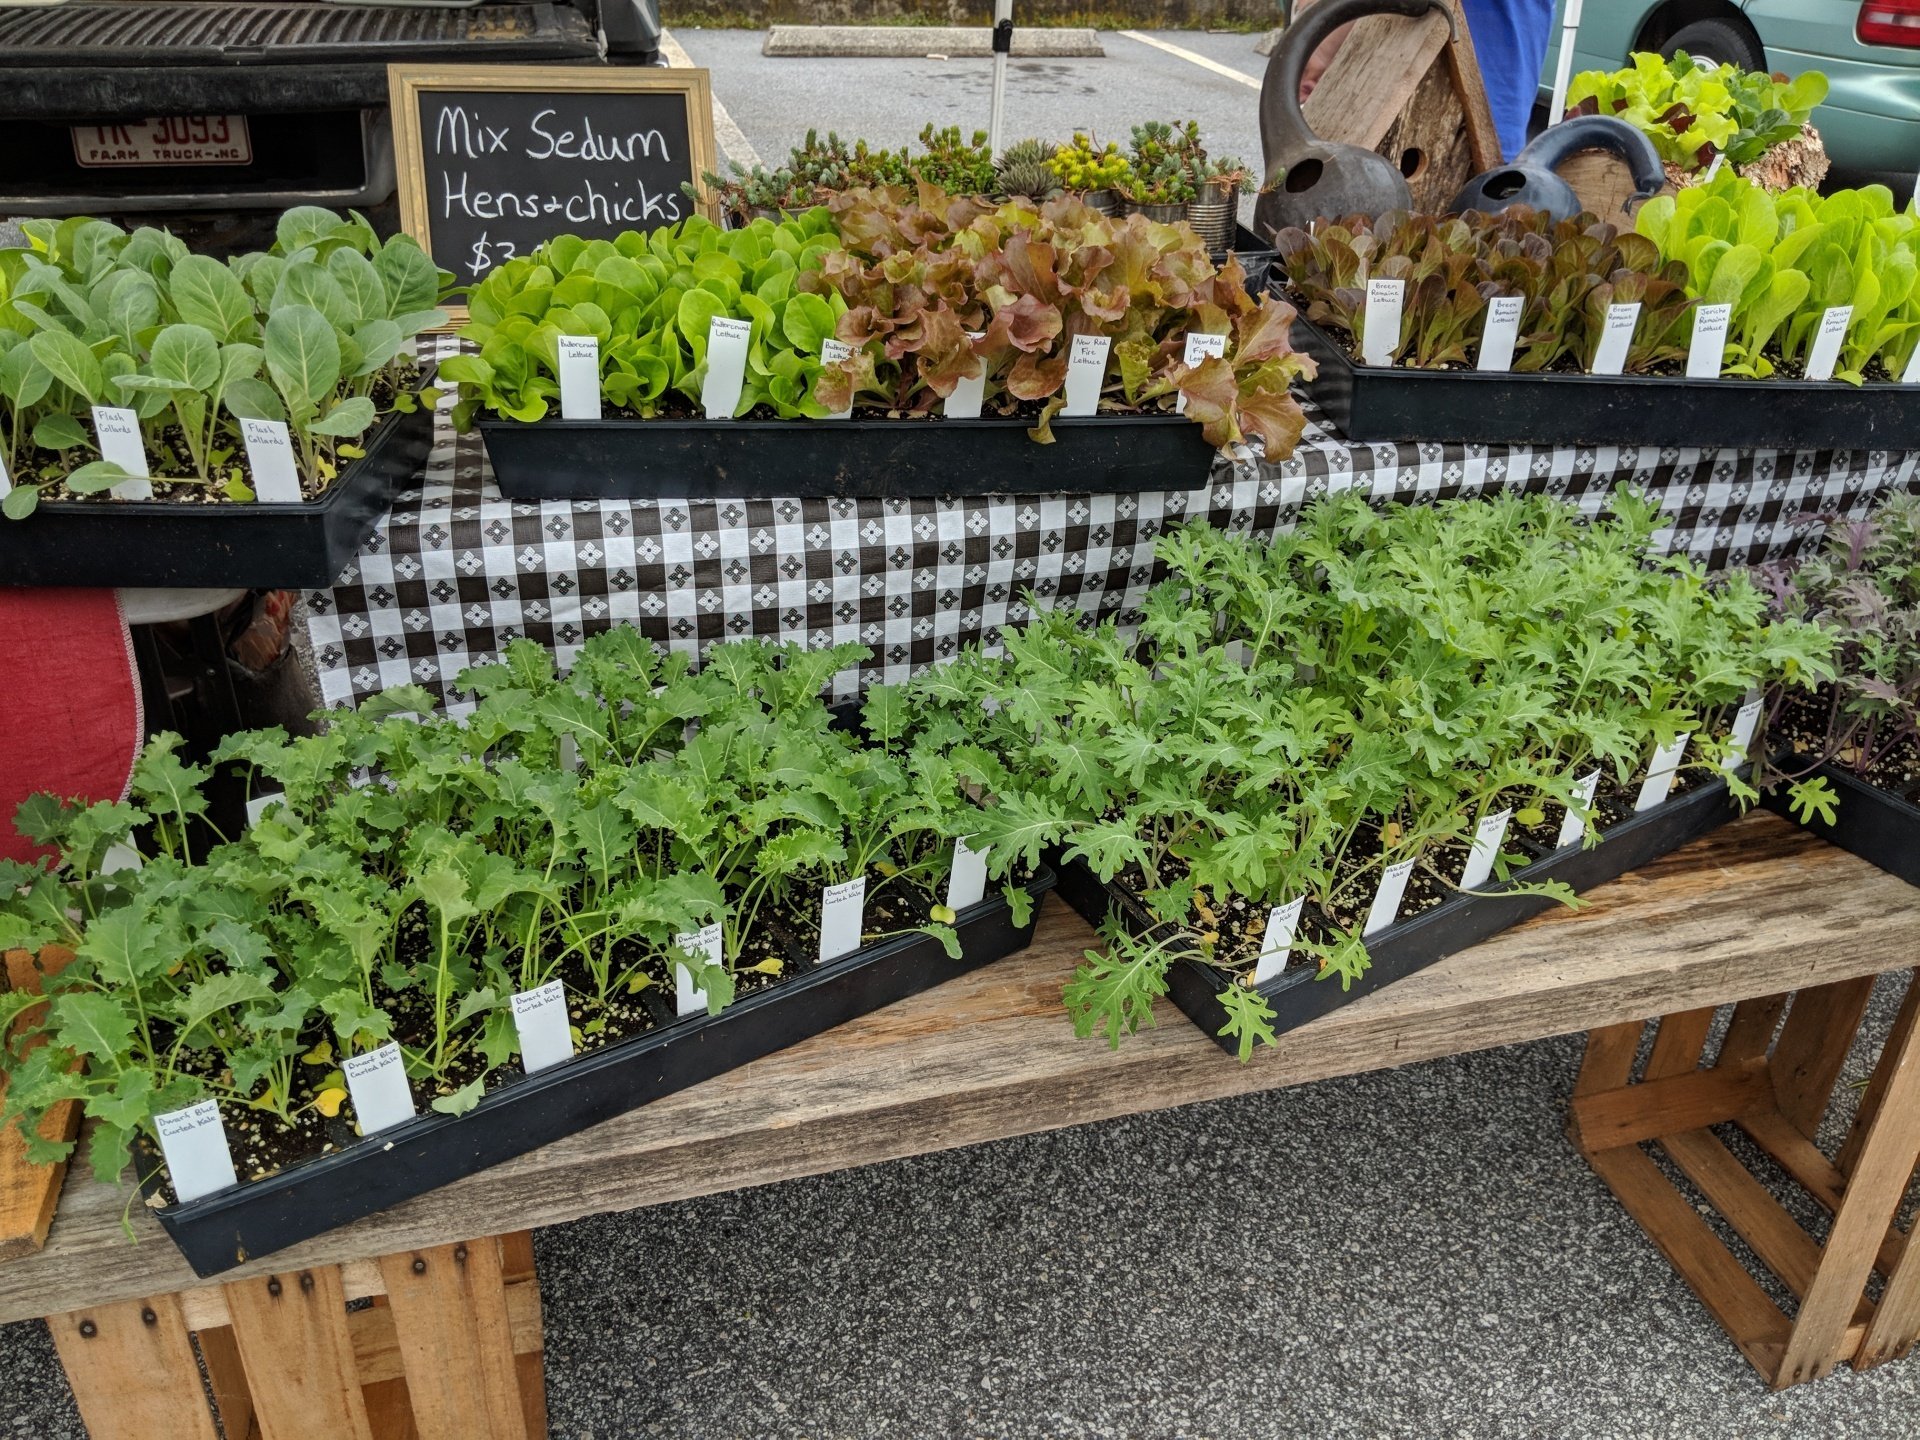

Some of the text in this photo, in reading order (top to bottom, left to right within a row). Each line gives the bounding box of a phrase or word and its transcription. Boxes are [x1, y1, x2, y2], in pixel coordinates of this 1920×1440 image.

[437, 105, 671, 162] Mix Sedum
[90, 150, 140, 161] FARM
[1076, 337, 1107, 346] New Red
[1192, 337, 1222, 346] New Red
[1081, 347, 1096, 356] Fire
[1073, 356, 1101, 365] Lettuce
[98, 411, 124, 421] Flash
[99, 423, 131, 433] Collards
[248, 422, 275, 434] Flash
[248, 434, 284, 445] Collards
[827, 886, 848, 897] Dwarf
[704, 927, 719, 936] Blue
[704, 935, 719, 944] Kale
[515, 985, 561, 1005] Dwarf Blue
[517, 994, 561, 1014] Curled Kale
[348, 1048, 399, 1069] Dwarf Blue
[350, 1056, 398, 1078] Curled Kale
[158, 1105, 216, 1127] Dwarf Blue
[162, 1115, 217, 1136] Curled Kale
